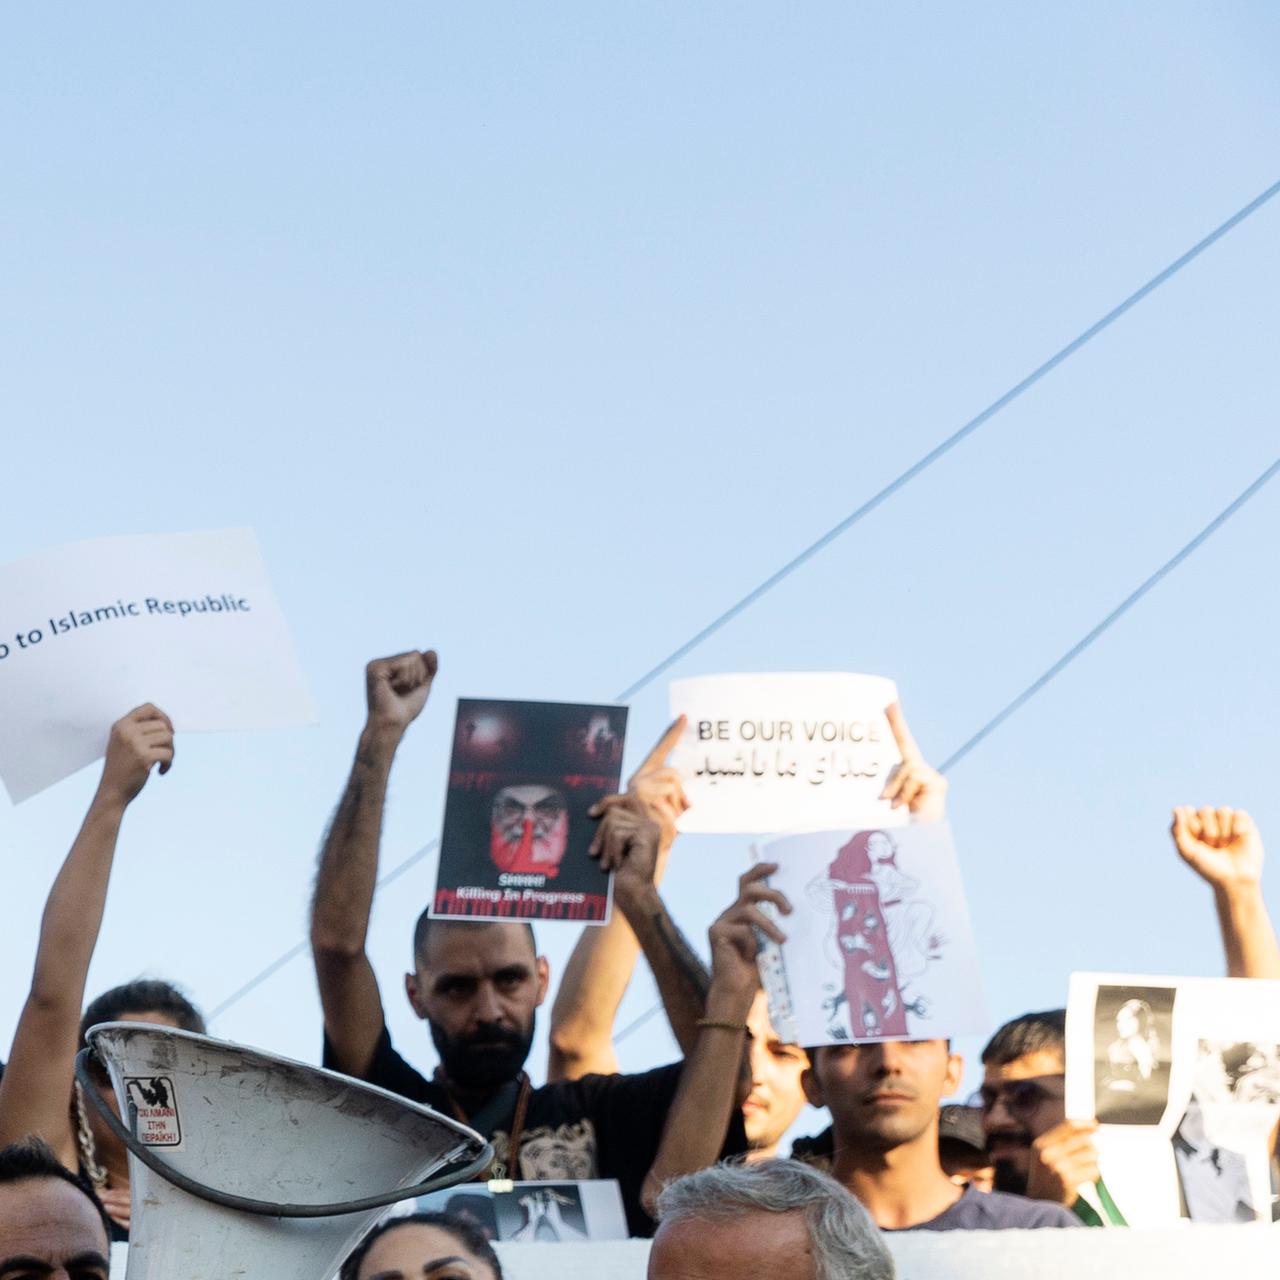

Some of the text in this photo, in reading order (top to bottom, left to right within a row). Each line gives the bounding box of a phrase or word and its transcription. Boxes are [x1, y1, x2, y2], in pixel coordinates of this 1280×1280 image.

[15, 628, 43, 648] to
[48, 600, 140, 635] Islamic
[144, 594, 251, 617] Republic
[698, 720, 881, 743] BE OUR VOICE
